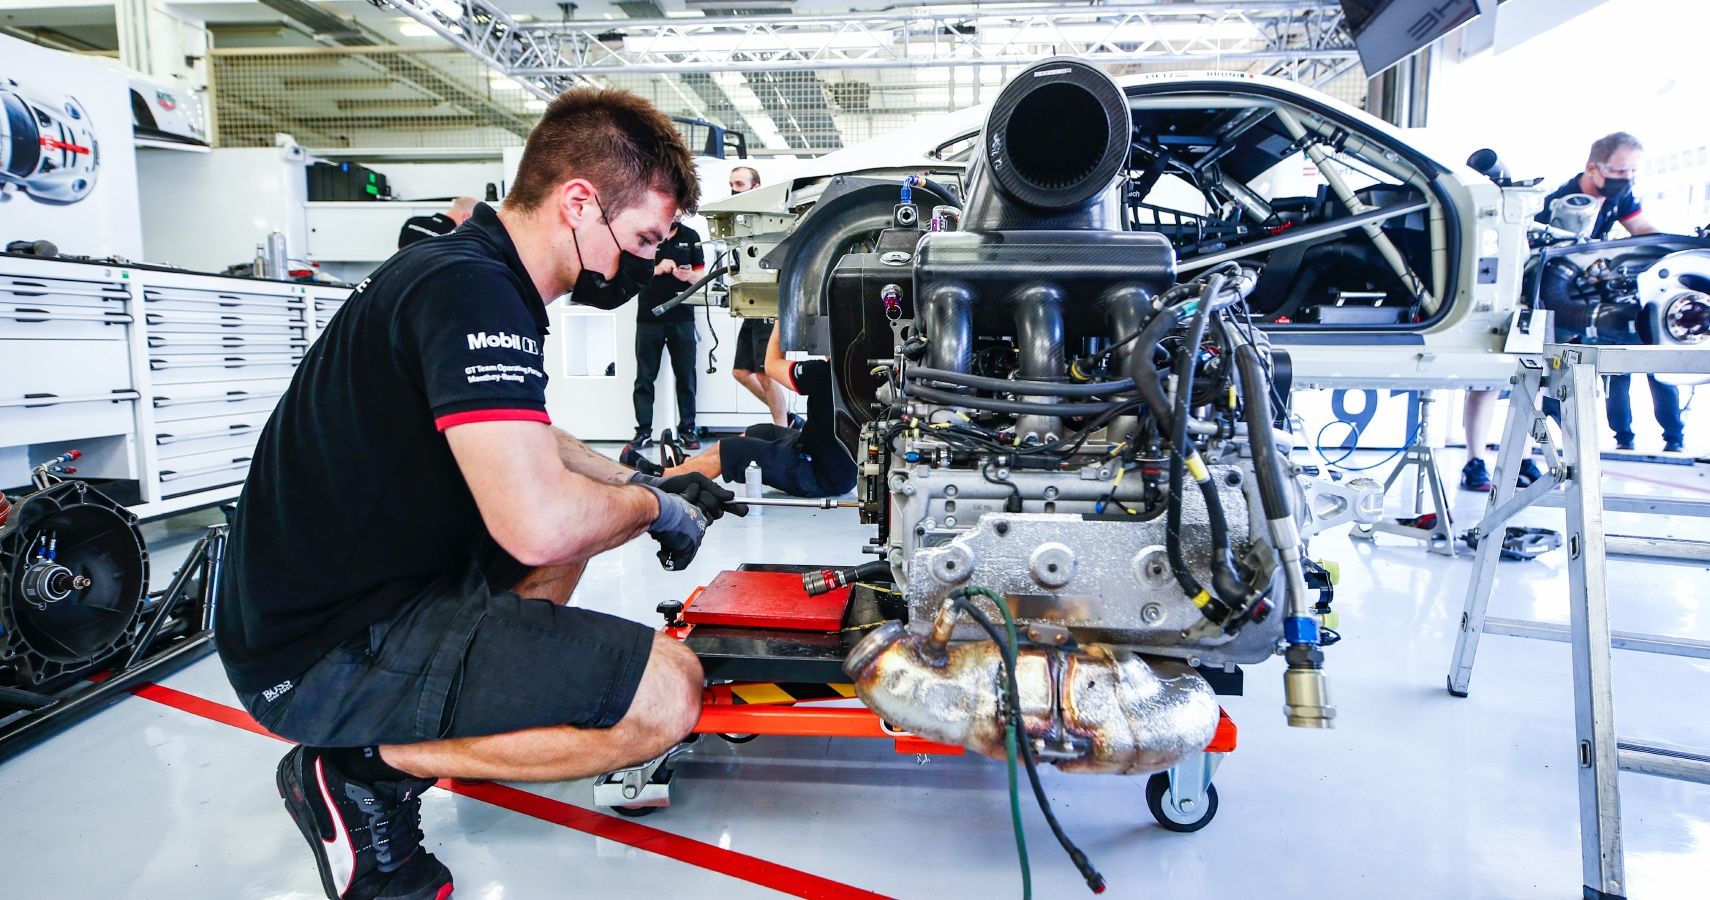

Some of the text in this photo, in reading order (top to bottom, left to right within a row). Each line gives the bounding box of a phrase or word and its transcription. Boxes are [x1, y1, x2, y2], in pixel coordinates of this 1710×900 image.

[467, 332, 521, 350] Mobil
[464, 366, 477, 374] GT
[497, 364, 528, 374] Operating
[1331, 388, 1418, 447] 91
